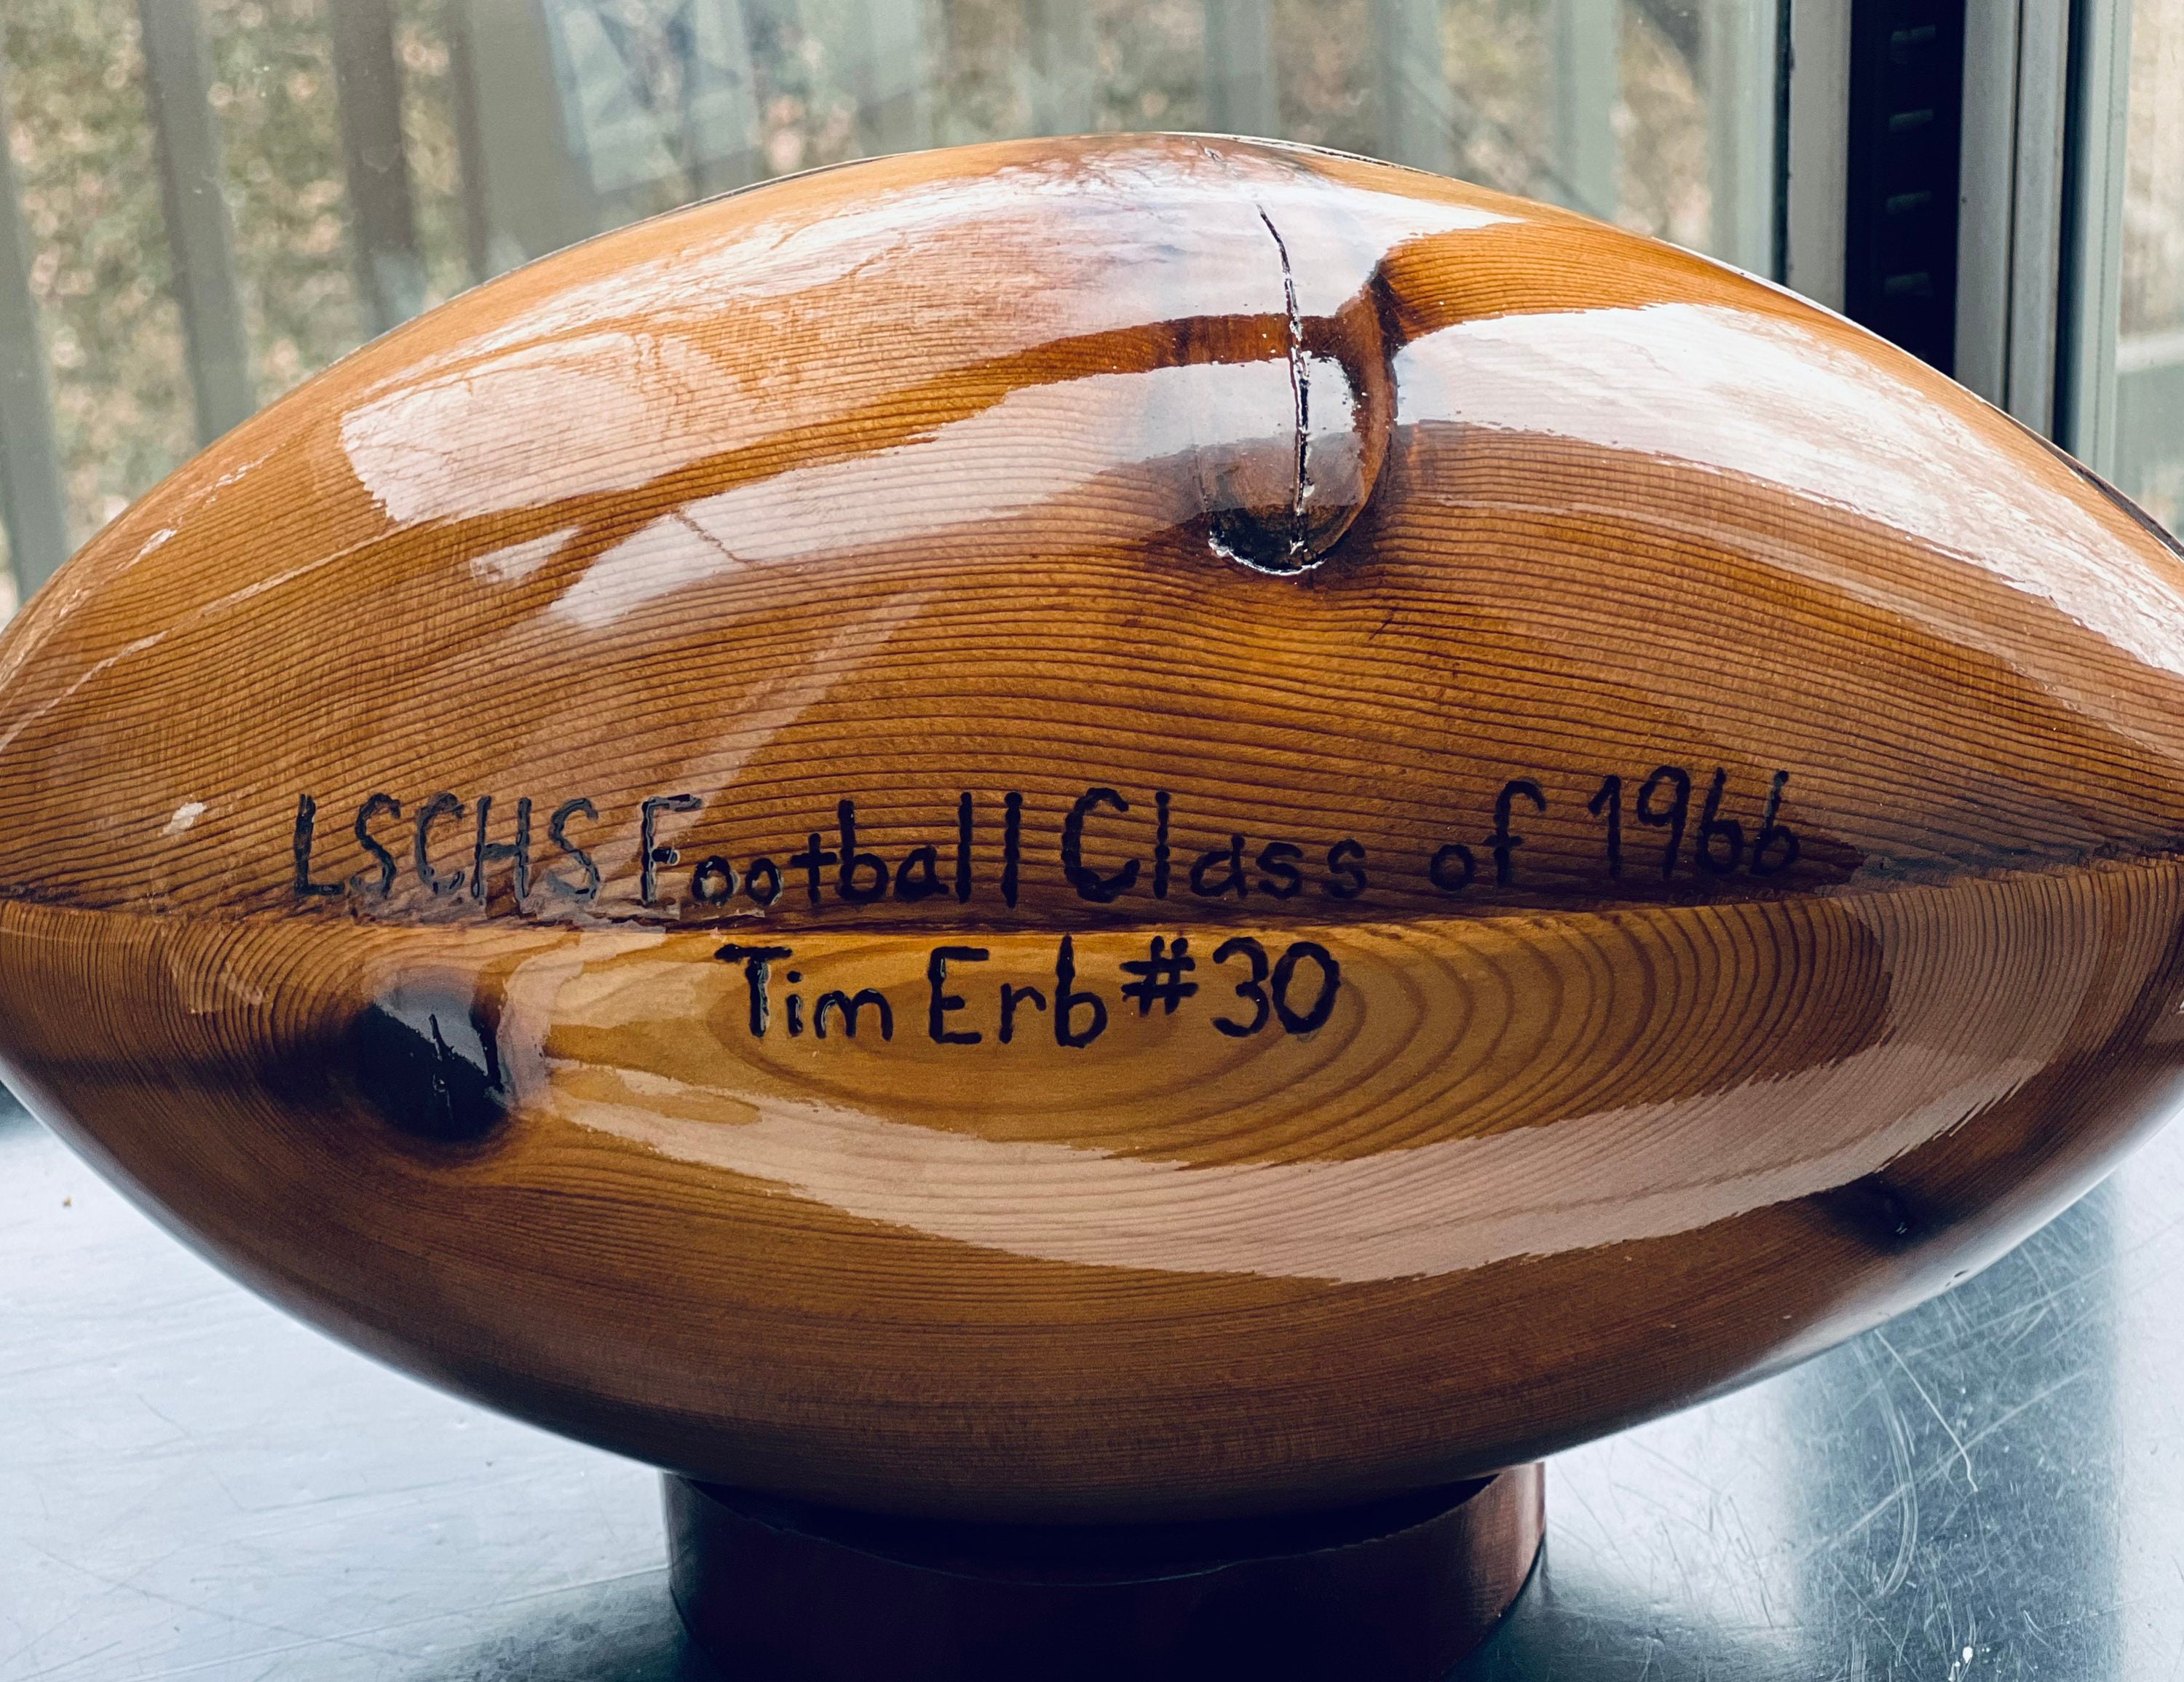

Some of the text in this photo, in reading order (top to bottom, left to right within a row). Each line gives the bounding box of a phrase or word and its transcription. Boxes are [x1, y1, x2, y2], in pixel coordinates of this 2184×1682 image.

[293, 765, 1800, 908] LSCHS Football Class of 1966
[714, 943, 894, 1041] Tim
